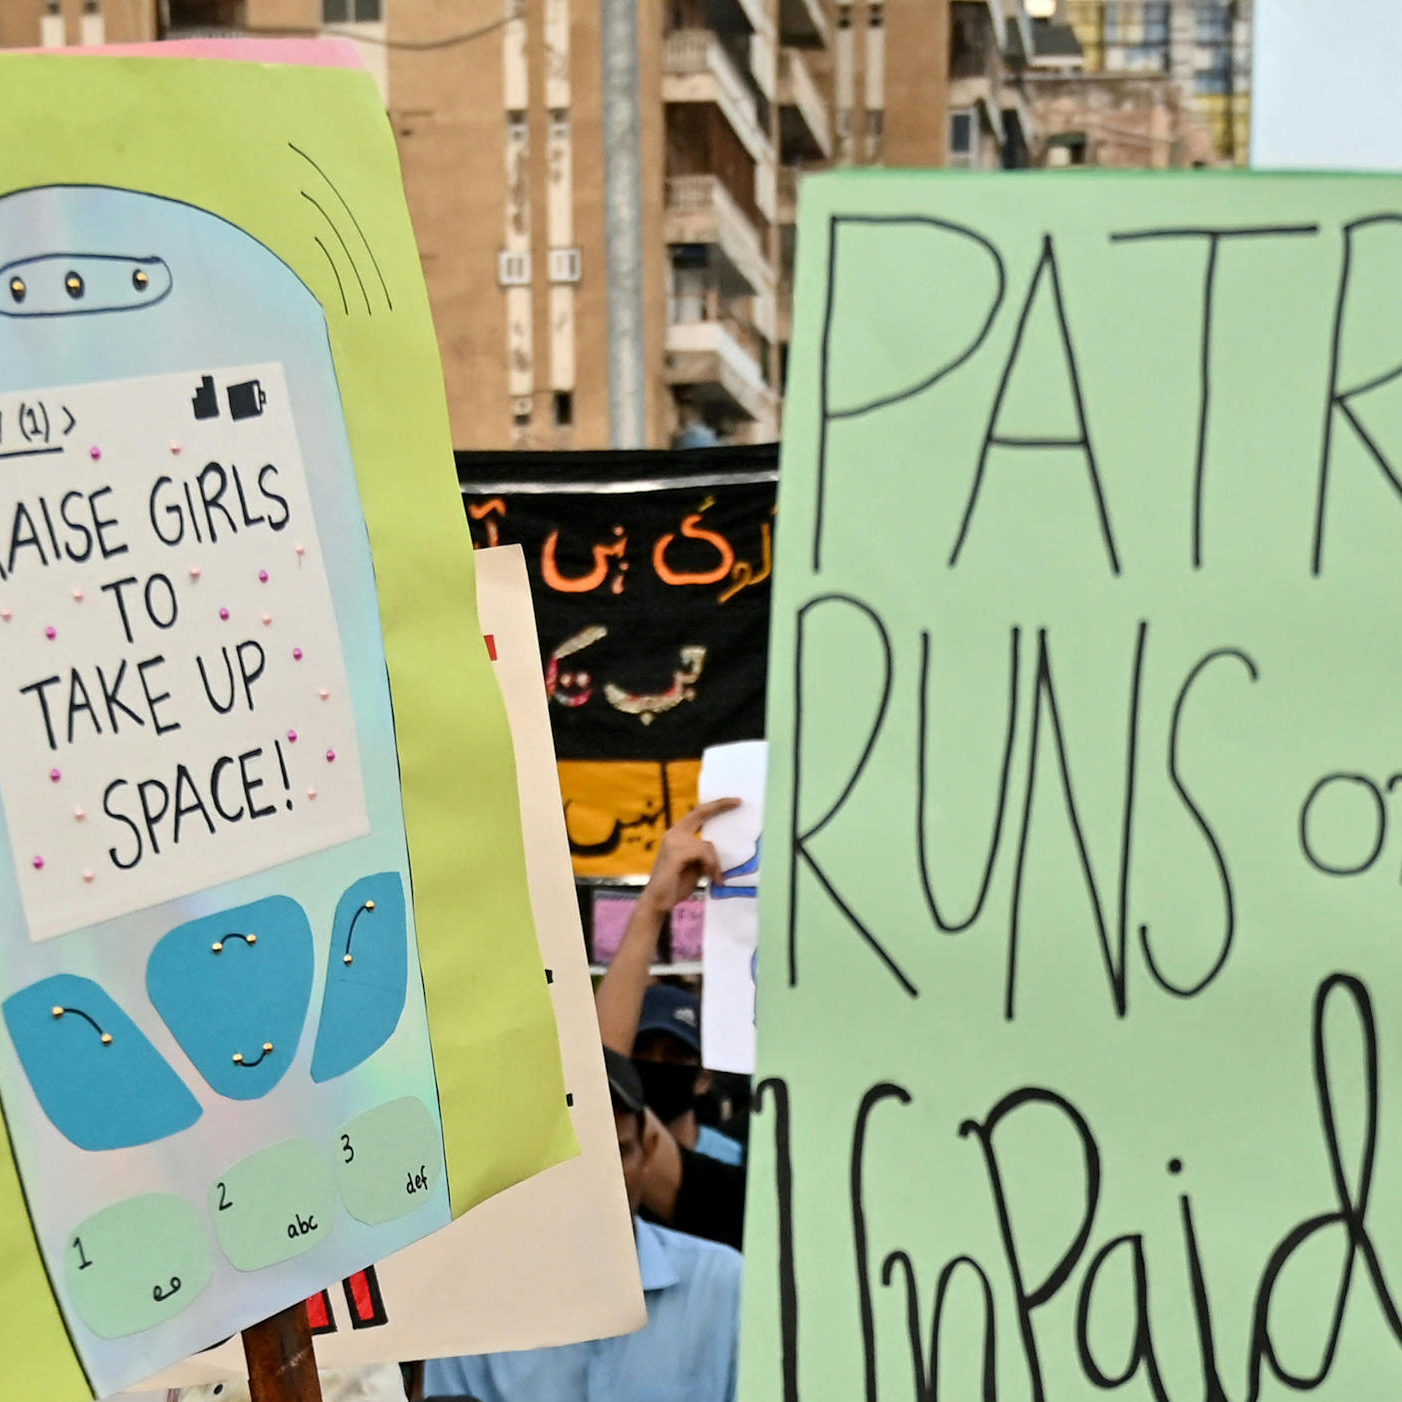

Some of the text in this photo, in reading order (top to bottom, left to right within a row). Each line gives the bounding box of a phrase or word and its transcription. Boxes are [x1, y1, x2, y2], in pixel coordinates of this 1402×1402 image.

[19, 402, 49, 442] (1)
[149, 461, 290, 546] GIRLS
[101, 573, 178, 643] TO
[19, 640, 265, 750] TAKE UP
[103, 740, 293, 869] SPACE!
[788, 595, 1257, 1019] RUNS
[340, 1133, 355, 1164] 3
[216, 1182, 233, 1212] 2
[406, 1165, 429, 1195] def
[287, 1213, 319, 1239] abc
[72, 1237, 93, 1270] 1
